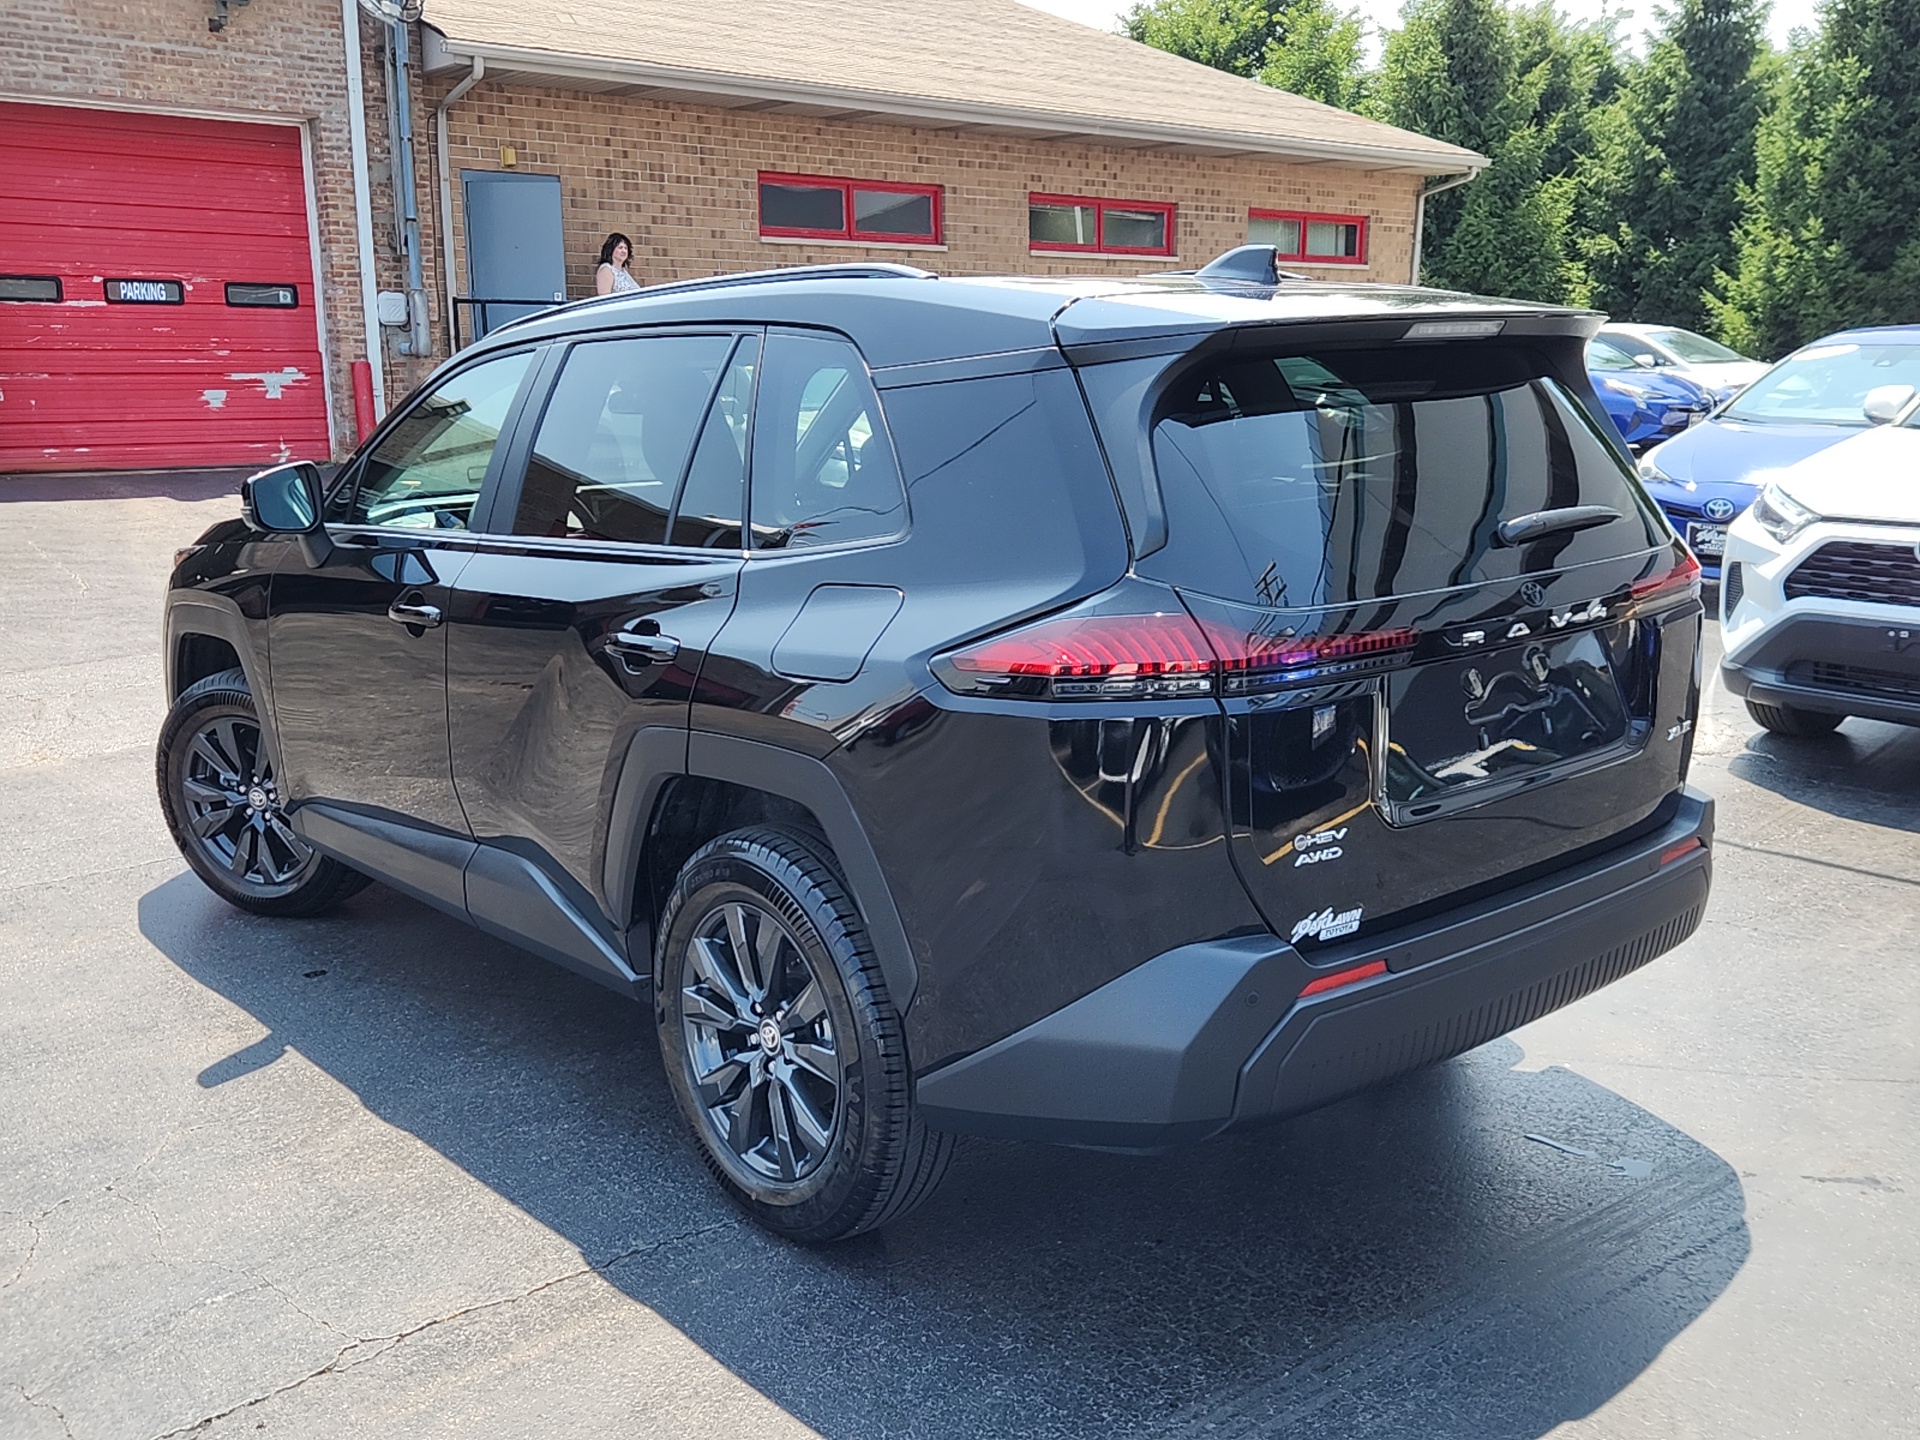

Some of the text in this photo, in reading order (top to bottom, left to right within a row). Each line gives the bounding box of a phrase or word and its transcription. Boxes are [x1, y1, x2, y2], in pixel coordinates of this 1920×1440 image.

[120, 281, 167, 301] PARKING
[1461, 597, 1608, 647] RAV4
[1294, 846, 1343, 867] AWD
[1324, 922, 1354, 938] TOYOTA
